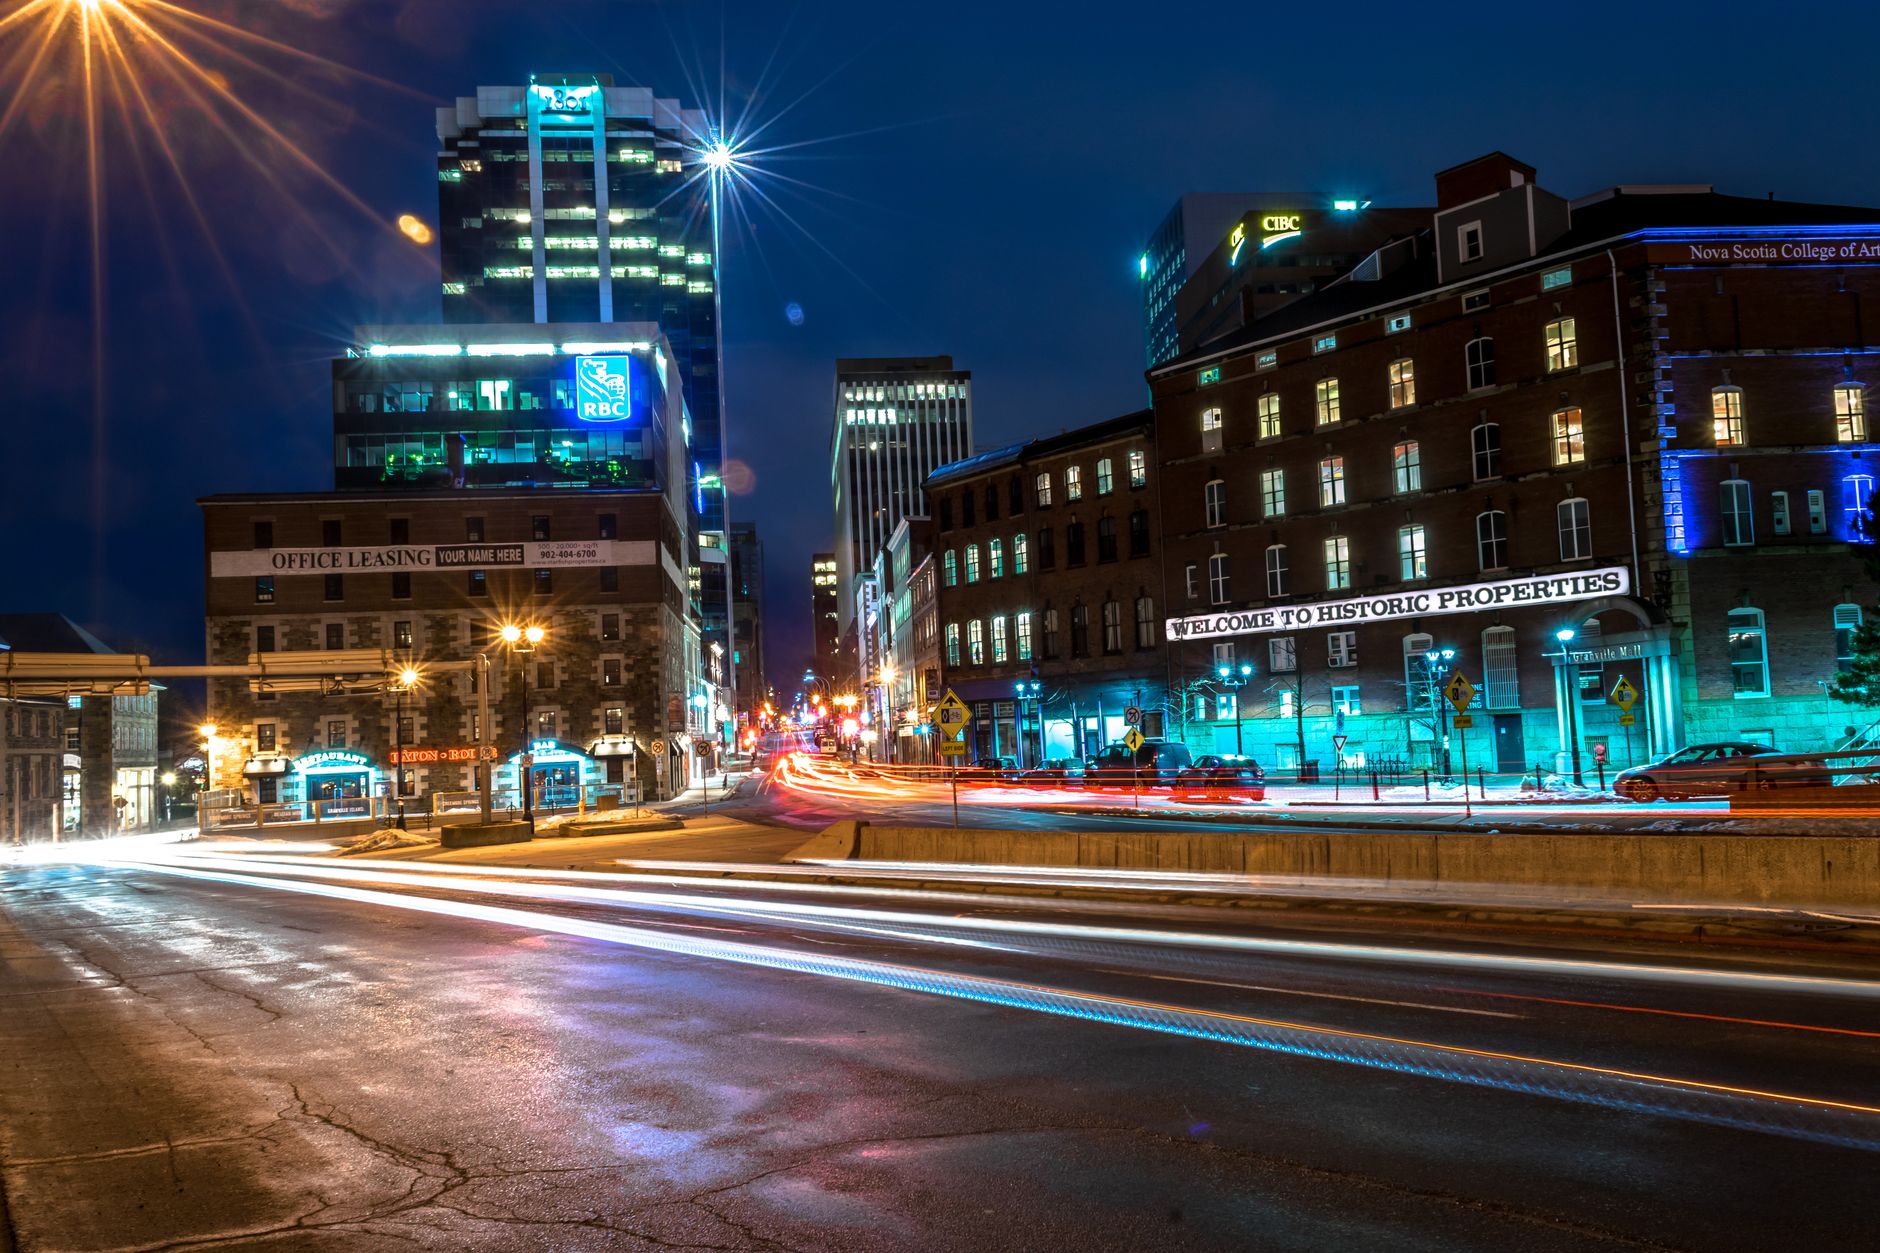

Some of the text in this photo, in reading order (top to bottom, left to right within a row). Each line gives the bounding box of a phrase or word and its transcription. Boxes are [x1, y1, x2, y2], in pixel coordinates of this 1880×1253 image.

[1263, 216, 1300, 231] CIBC
[1689, 245, 1729, 260] Nova
[1733, 244, 1777, 259] Scotia
[1781, 243, 1836, 261] College
[1839, 242, 1856, 257] of
[584, 402, 625, 416] RBC
[272, 549, 597, 569] OFFICE LEASING YOUR NAME HERE 902-404-6700
[1172, 572, 1621, 637] WELCOME TO HISTORIC PROPERTIES
[1620, 645, 1641, 657] Mall
[533, 741, 556, 749] BAR
[291, 752, 367, 769] RESTAURANT
